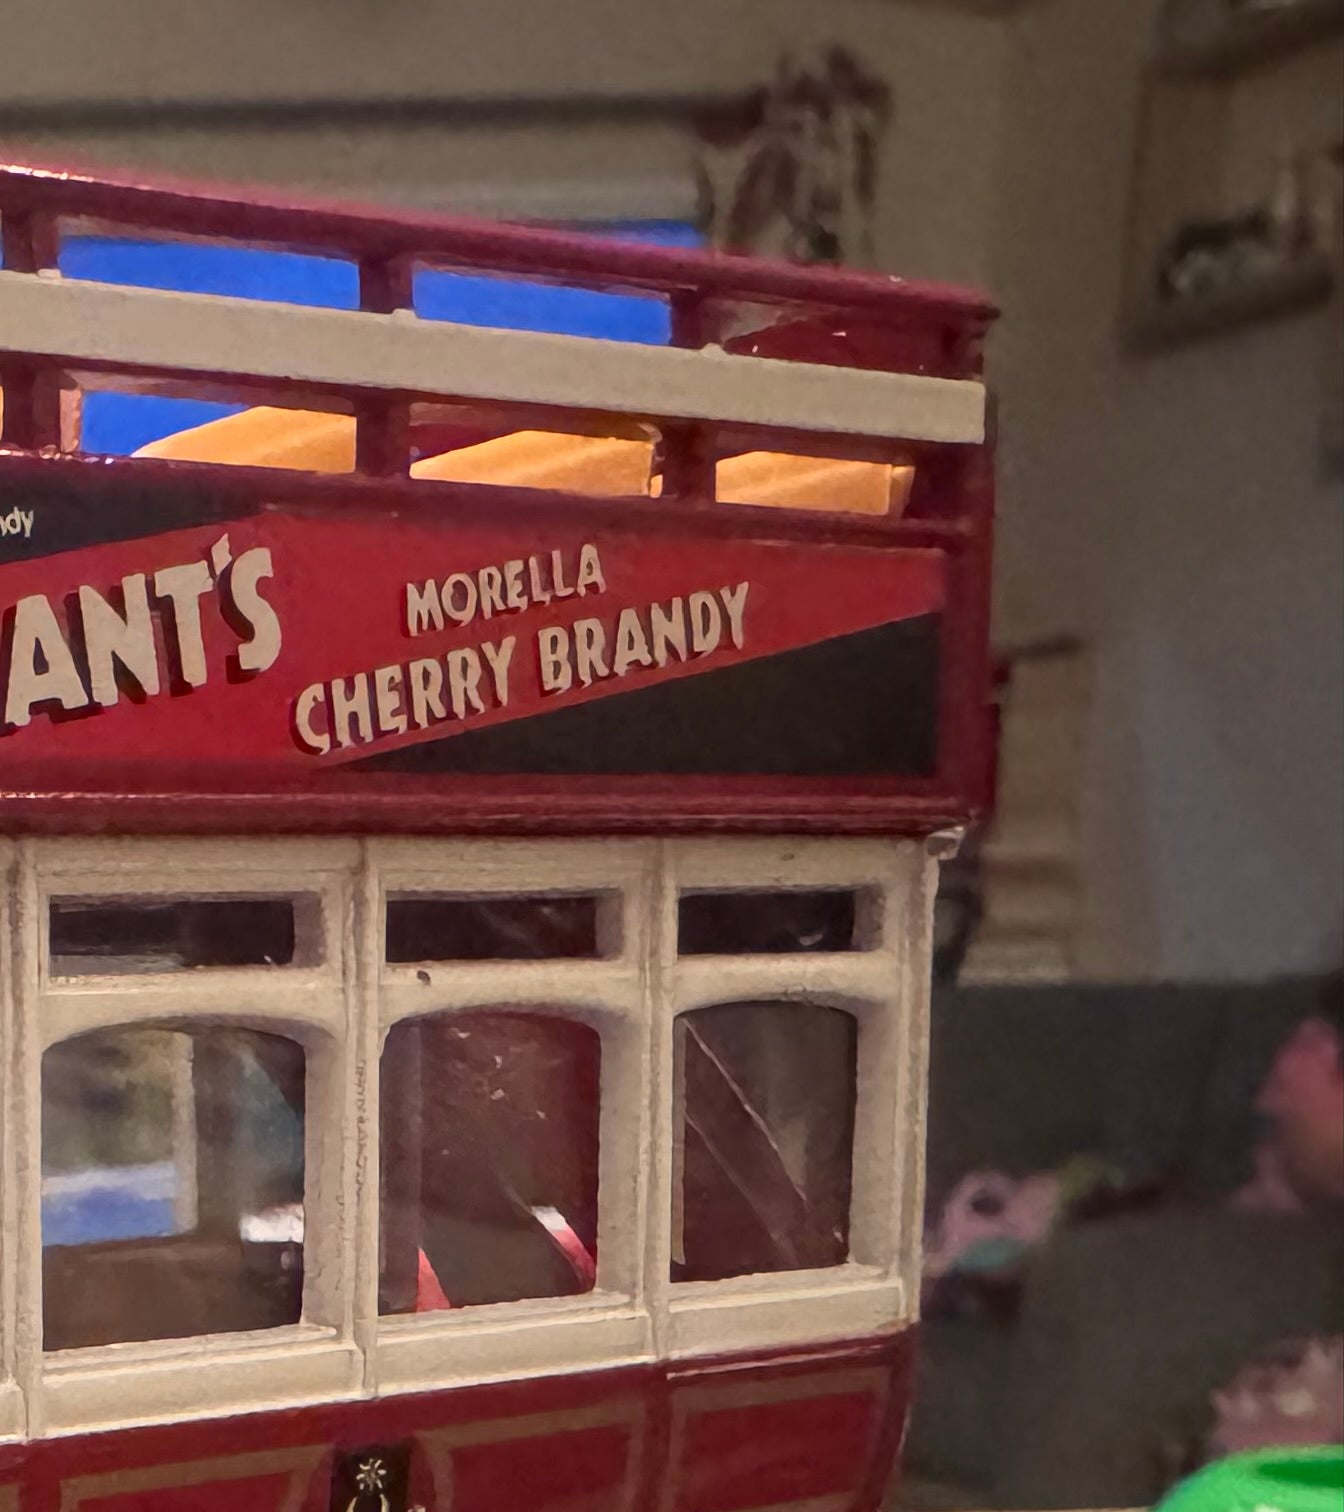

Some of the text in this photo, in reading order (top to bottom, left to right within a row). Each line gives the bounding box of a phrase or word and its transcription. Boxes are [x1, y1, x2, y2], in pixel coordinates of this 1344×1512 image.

[405, 543, 607, 638] MORELLA
[288, 580, 752, 758] CHERRY BRANDY
